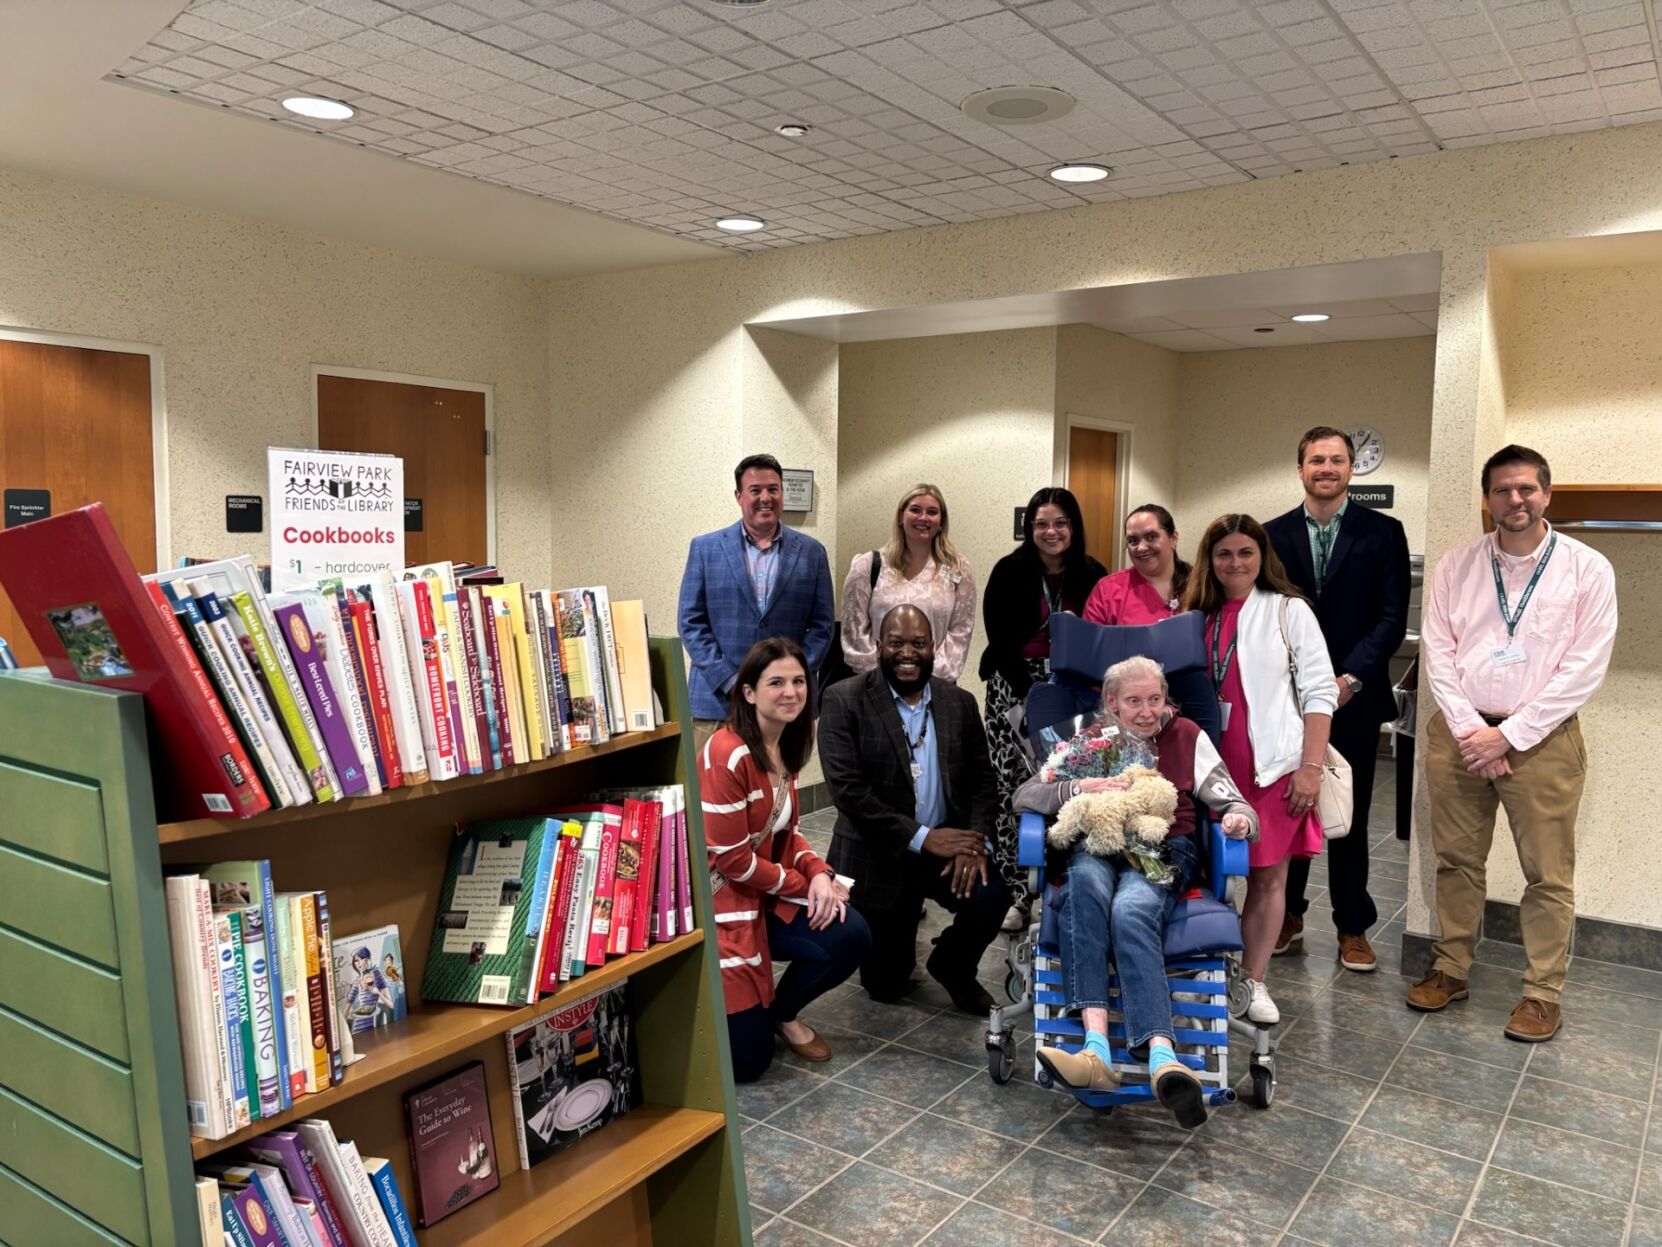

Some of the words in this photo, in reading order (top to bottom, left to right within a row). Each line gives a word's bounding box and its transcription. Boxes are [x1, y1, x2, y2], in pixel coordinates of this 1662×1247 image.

[285, 460, 352, 478] FAIRVIEW
[358, 466, 392, 481] PARK
[285, 497, 335, 511] FRIENDS
[348, 500, 393, 512] LIBRARY
[1348, 492, 1386, 500] rooms
[284, 527, 395, 543] Cookbooks
[290, 560, 301, 573] $1
[326, 561, 390, 573] hardcover
[186, 602, 199, 619] 2011
[245, 605, 259, 631] Katie
[257, 633, 275, 671] Brown's
[160, 604, 180, 635] CONTEST
[178, 637, 197, 668] WINNING
[193, 669, 211, 698] ANNUAL
[208, 698, 226, 725] RECIPES
[222, 726, 235, 744] 2010
[221, 624, 233, 642] QUICK
[230, 644, 246, 670] COOKING
[244, 672, 258, 695] ANNUAL
[256, 697, 270, 721] RECIPES
[452, 610, 460, 635] TAPAS
[457, 643, 467, 678] SPANISH
[463, 680, 474, 719] COOKERY
[462, 610, 476, 655] Seaboard
[471, 667, 486, 715] Sideboard
[199, 626, 212, 649] QUICK
[211, 651, 231, 685] COOKING
[229, 688, 246, 716] ANNUAL
[244, 718, 262, 747] RECIPES
[339, 648, 356, 691] Diabetes
[350, 695, 369, 749] COOKBOOK
[322, 701, 333, 716] Pies
[429, 666, 444, 712] HOMEFRONT
[437, 716, 449, 750] COOKING
[224, 754, 244, 784] BORDERS
[576, 852, 585, 870] 365
[600, 832, 612, 888] COOKBOOK
[573, 871, 581, 893] Easy
[195, 912, 206, 943] Country
[266, 900, 275, 932] COOKING
[301, 898, 313, 932] Apple
[232, 932, 241, 951] PIE
[306, 934, 316, 950] Pie
[564, 924, 574, 950] Recip
[210, 950, 218, 991] COOKERY
[235, 954, 248, 1022] COOKBOOK
[253, 976, 276, 1060] BAKING
[553, 1001, 594, 1028] INSTYLE
[418, 1114, 432, 1124] The
[434, 1096, 466, 1117] Everyday
[419, 1120, 442, 1135] Guide
[452, 1105, 472, 1118] Wine
[348, 1155, 368, 1193] BAKING
[363, 1194, 376, 1211] from
[370, 1210, 381, 1223] the
[382, 1174, 400, 1214] Bocadillos
[223, 1209, 236, 1224] Eat
[228, 1222, 241, 1235] Up
[353, 1193, 372, 1228] COUNTRY
[366, 1226, 381, 1247] COO
